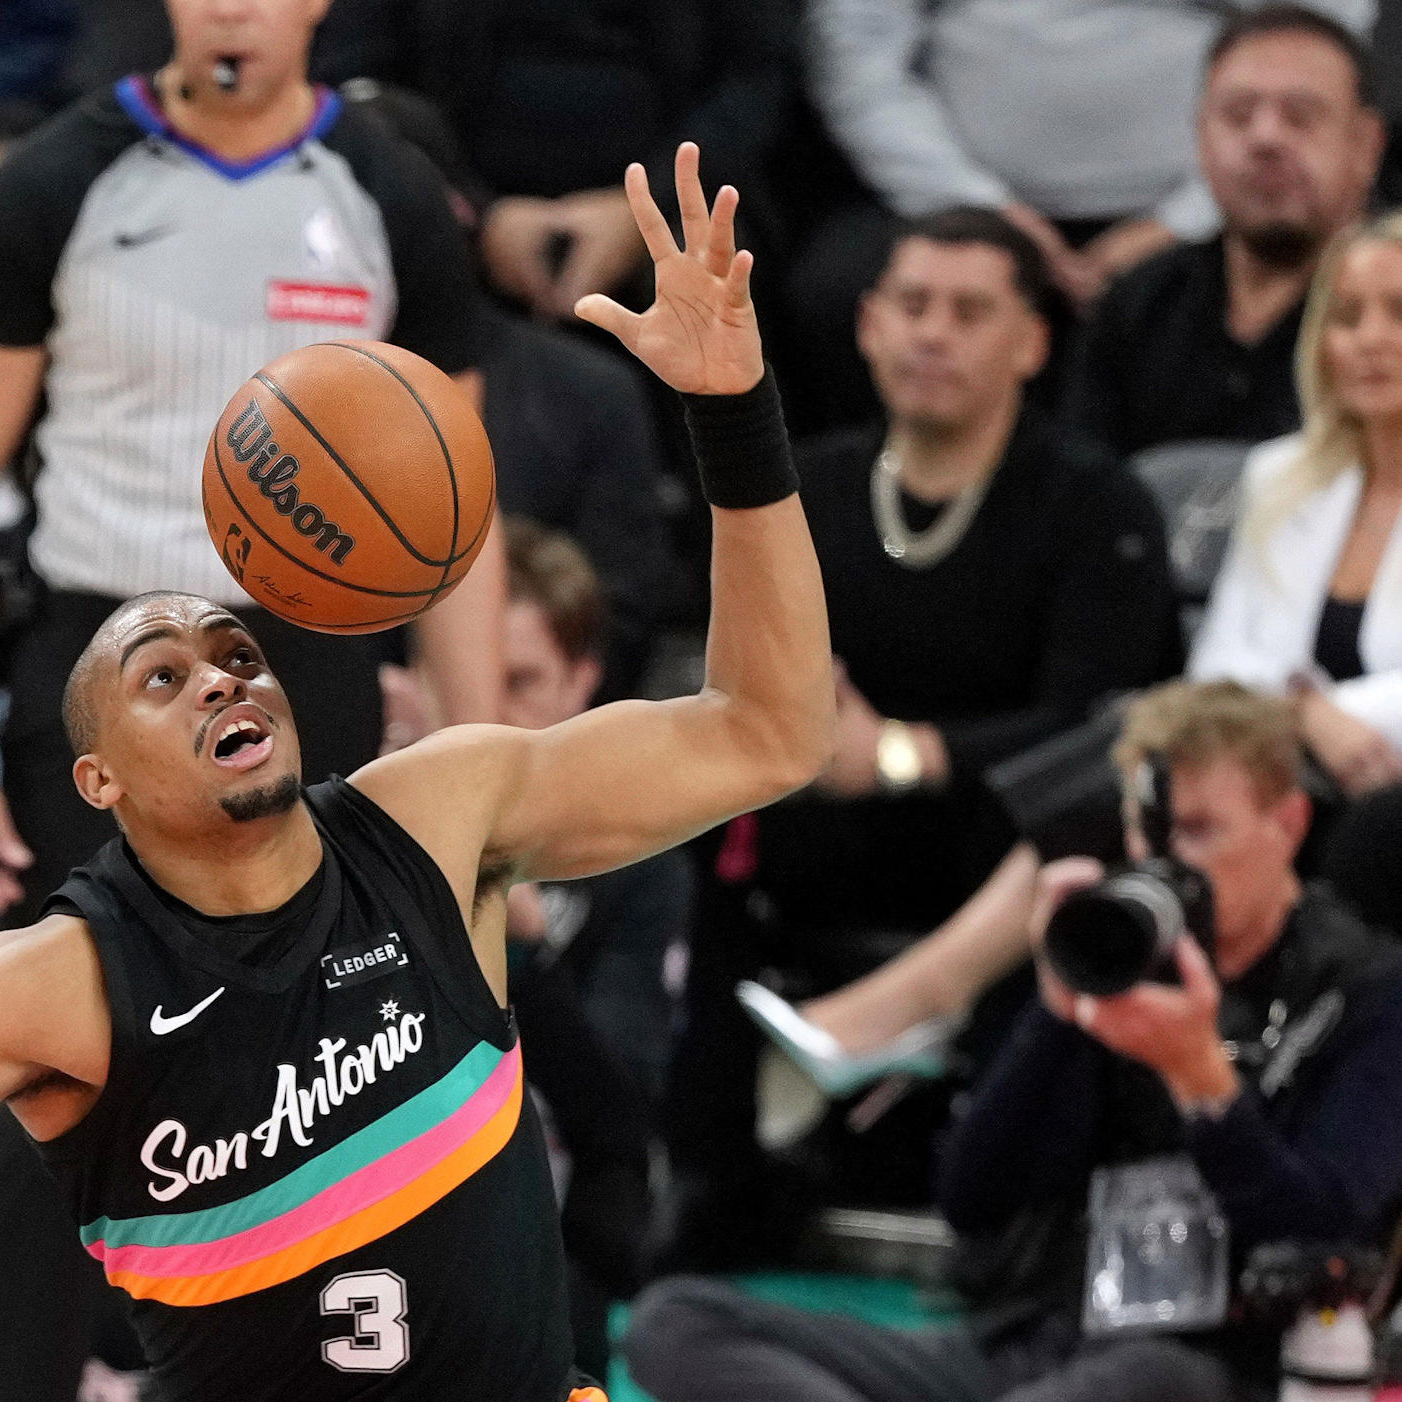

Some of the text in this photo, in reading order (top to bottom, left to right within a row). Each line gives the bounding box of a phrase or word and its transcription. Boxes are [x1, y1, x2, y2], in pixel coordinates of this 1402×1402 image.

[226, 397, 356, 567] Wilson
[333, 943, 398, 977] LEDGER
[140, 1012, 426, 1202] San Antonio
[319, 1267, 410, 1374] 3
